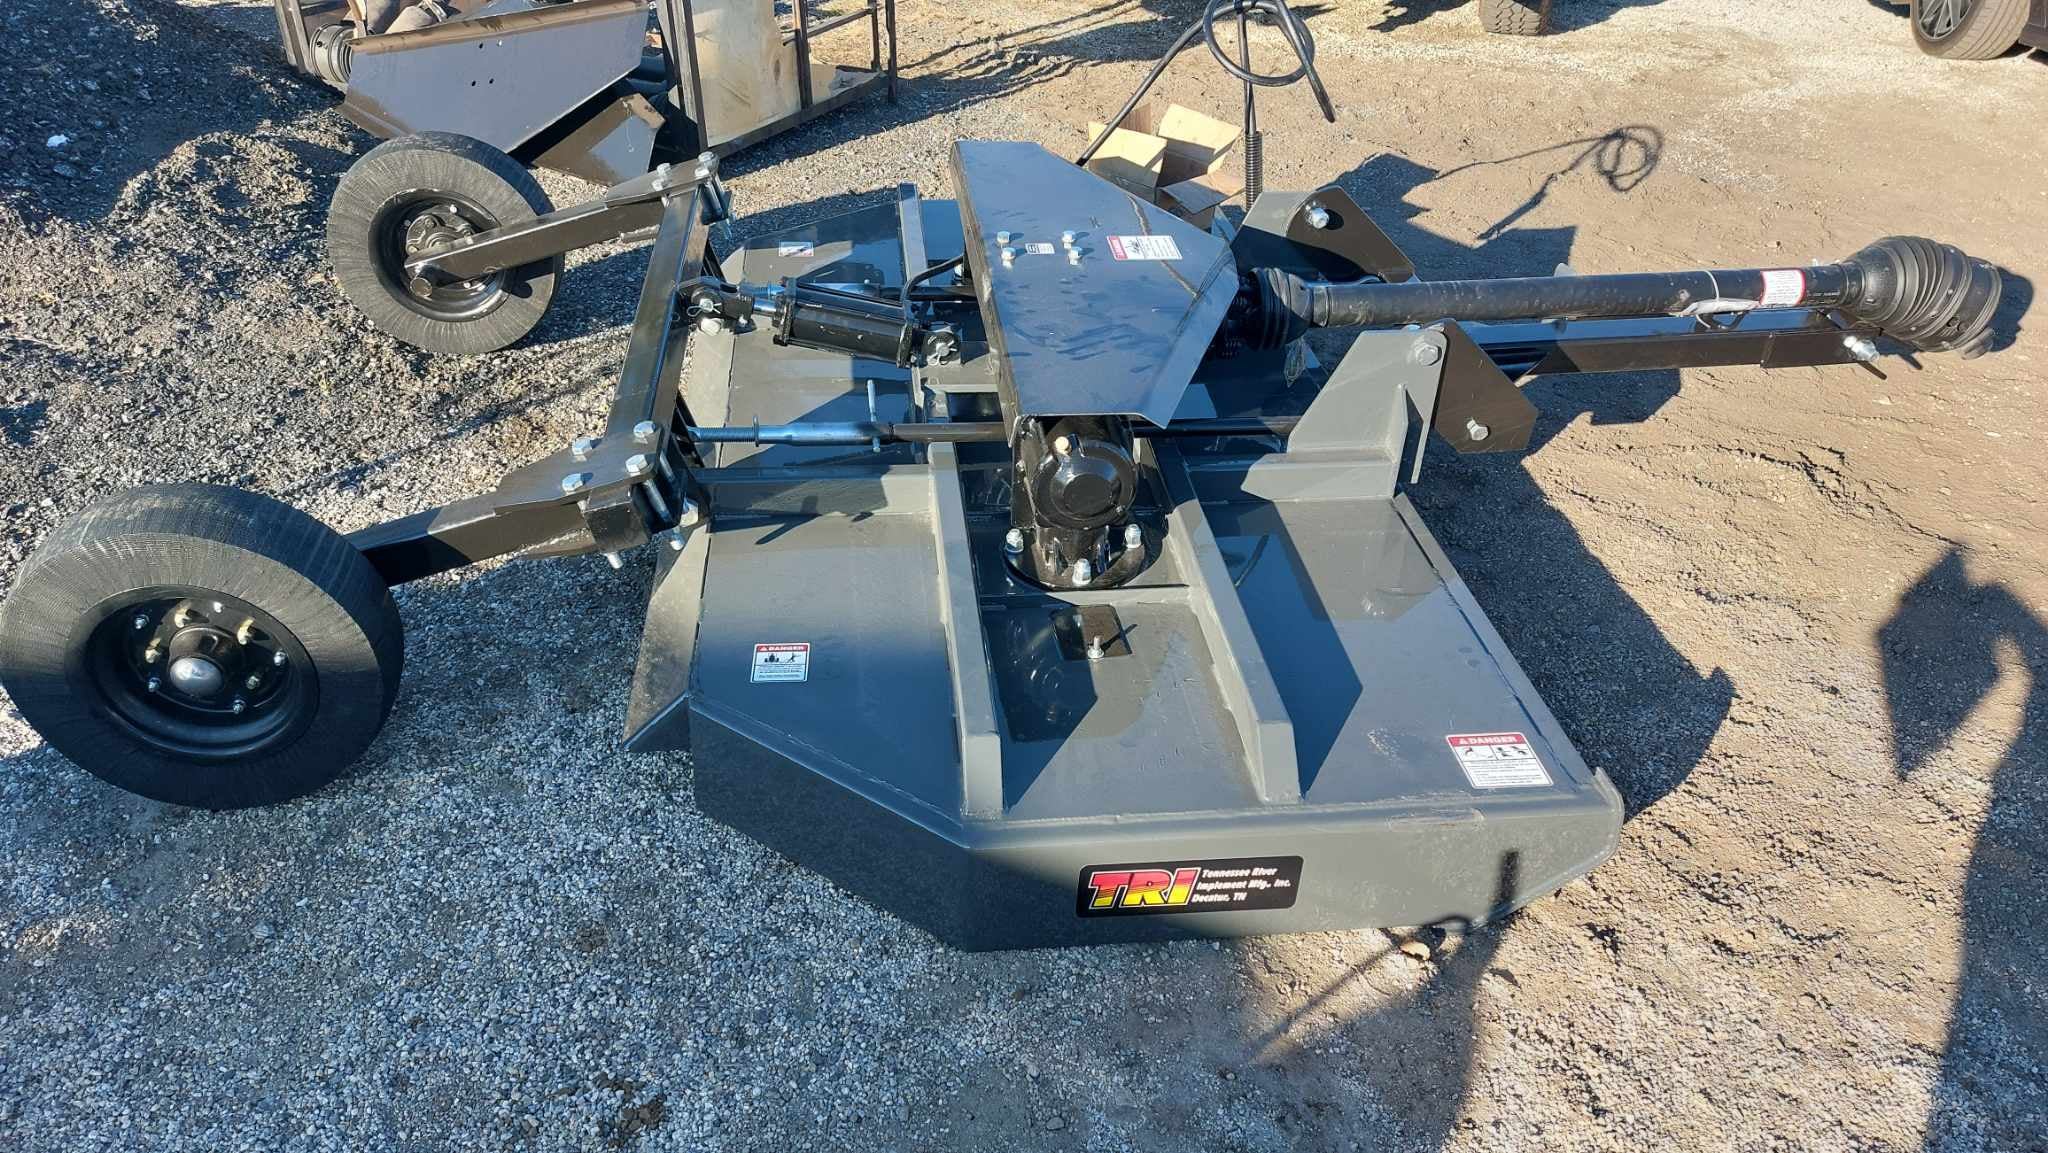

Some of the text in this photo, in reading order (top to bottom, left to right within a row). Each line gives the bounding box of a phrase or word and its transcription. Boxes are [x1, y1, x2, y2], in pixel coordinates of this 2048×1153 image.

[1469, 736, 1518, 744] DANGER
[1202, 867, 1277, 878] Tennessee River
[1088, 868, 1200, 910] TRI
[1197, 880, 1247, 891] Implement
[1274, 878, 1291, 887] Inc.
[1192, 892, 1247, 903] Decatur, TN
